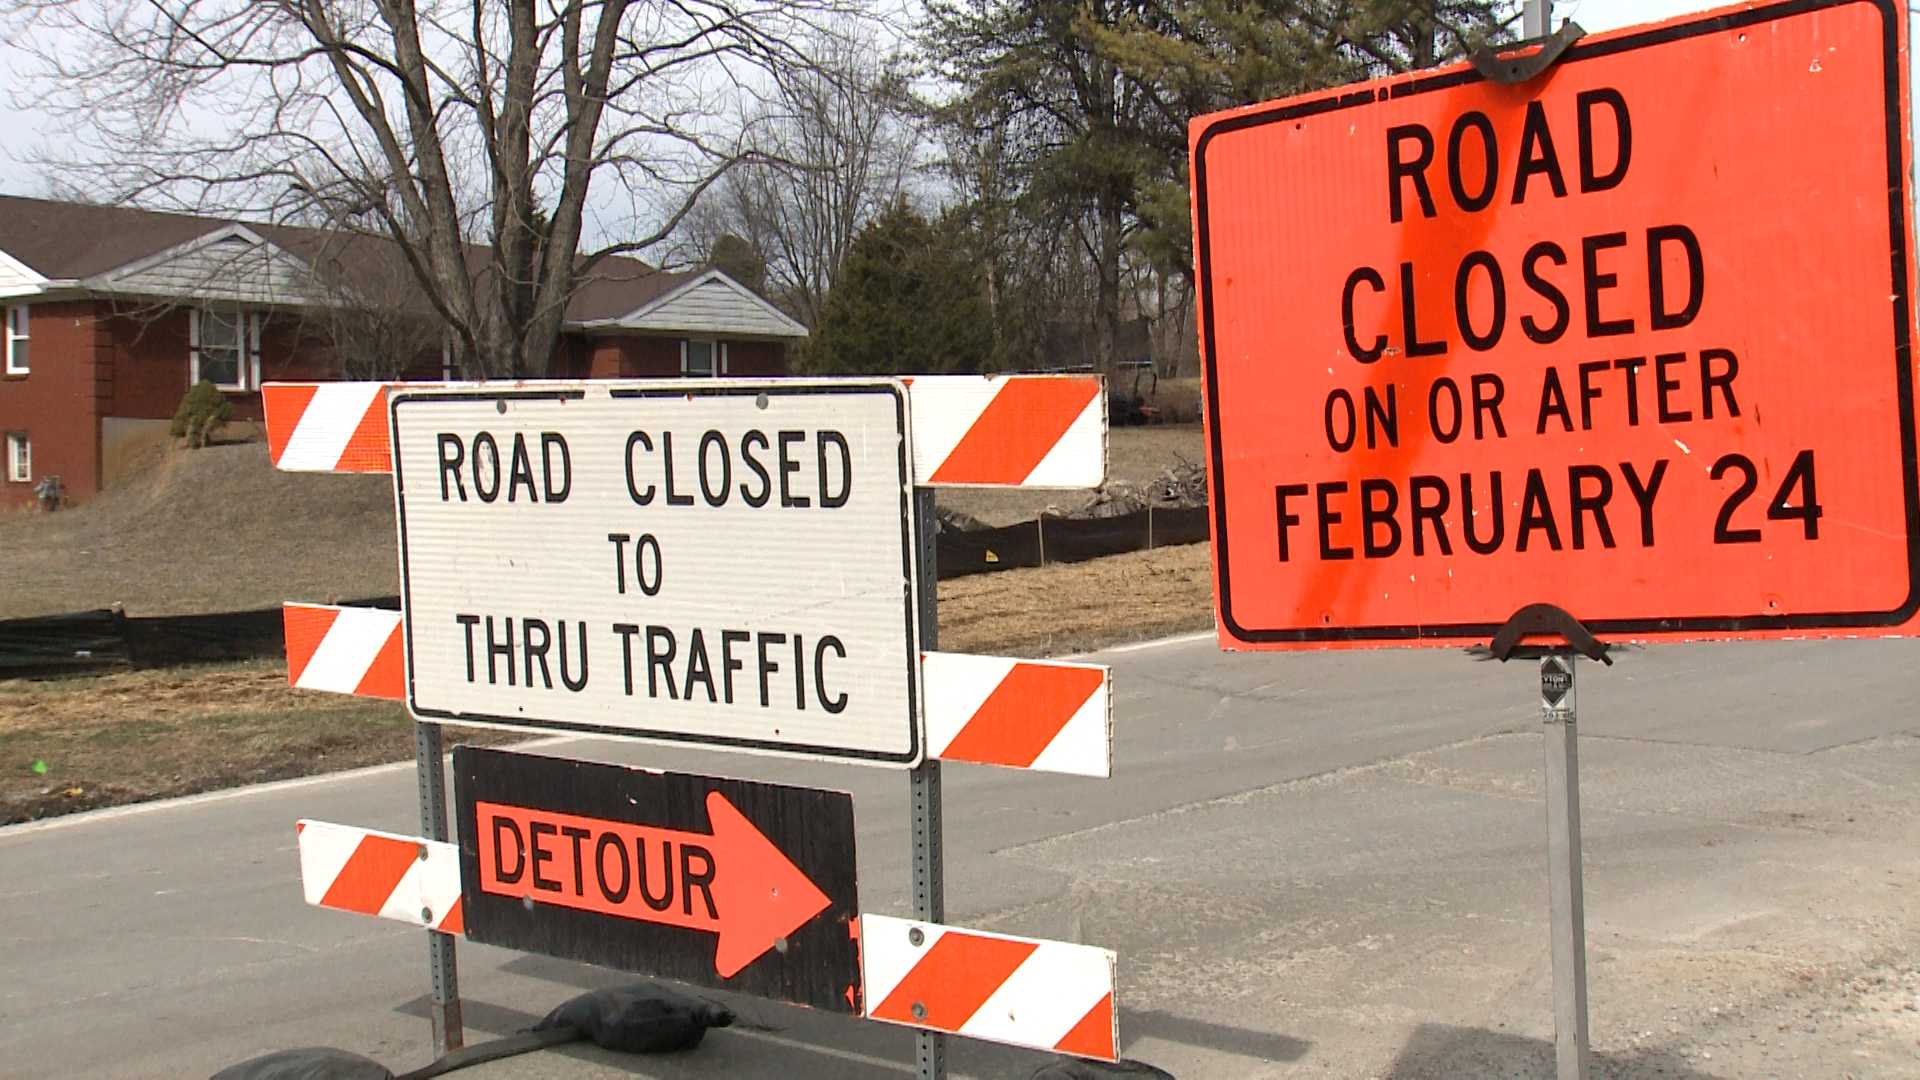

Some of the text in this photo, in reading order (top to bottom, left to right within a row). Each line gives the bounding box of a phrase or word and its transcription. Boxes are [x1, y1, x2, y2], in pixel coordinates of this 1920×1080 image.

[1386, 87, 1632, 223] ROAD
[1342, 224, 1704, 364] CLOSED
[1325, 348, 1741, 452] ON OR AFTER
[437, 429, 852, 508] ROAD CLOSED
[1275, 449, 1823, 562] FEBRUARY 24
[607, 533, 663, 596] TO
[456, 614, 848, 713] THRU TRAFFIC
[493, 815, 719, 920] DETOUR
